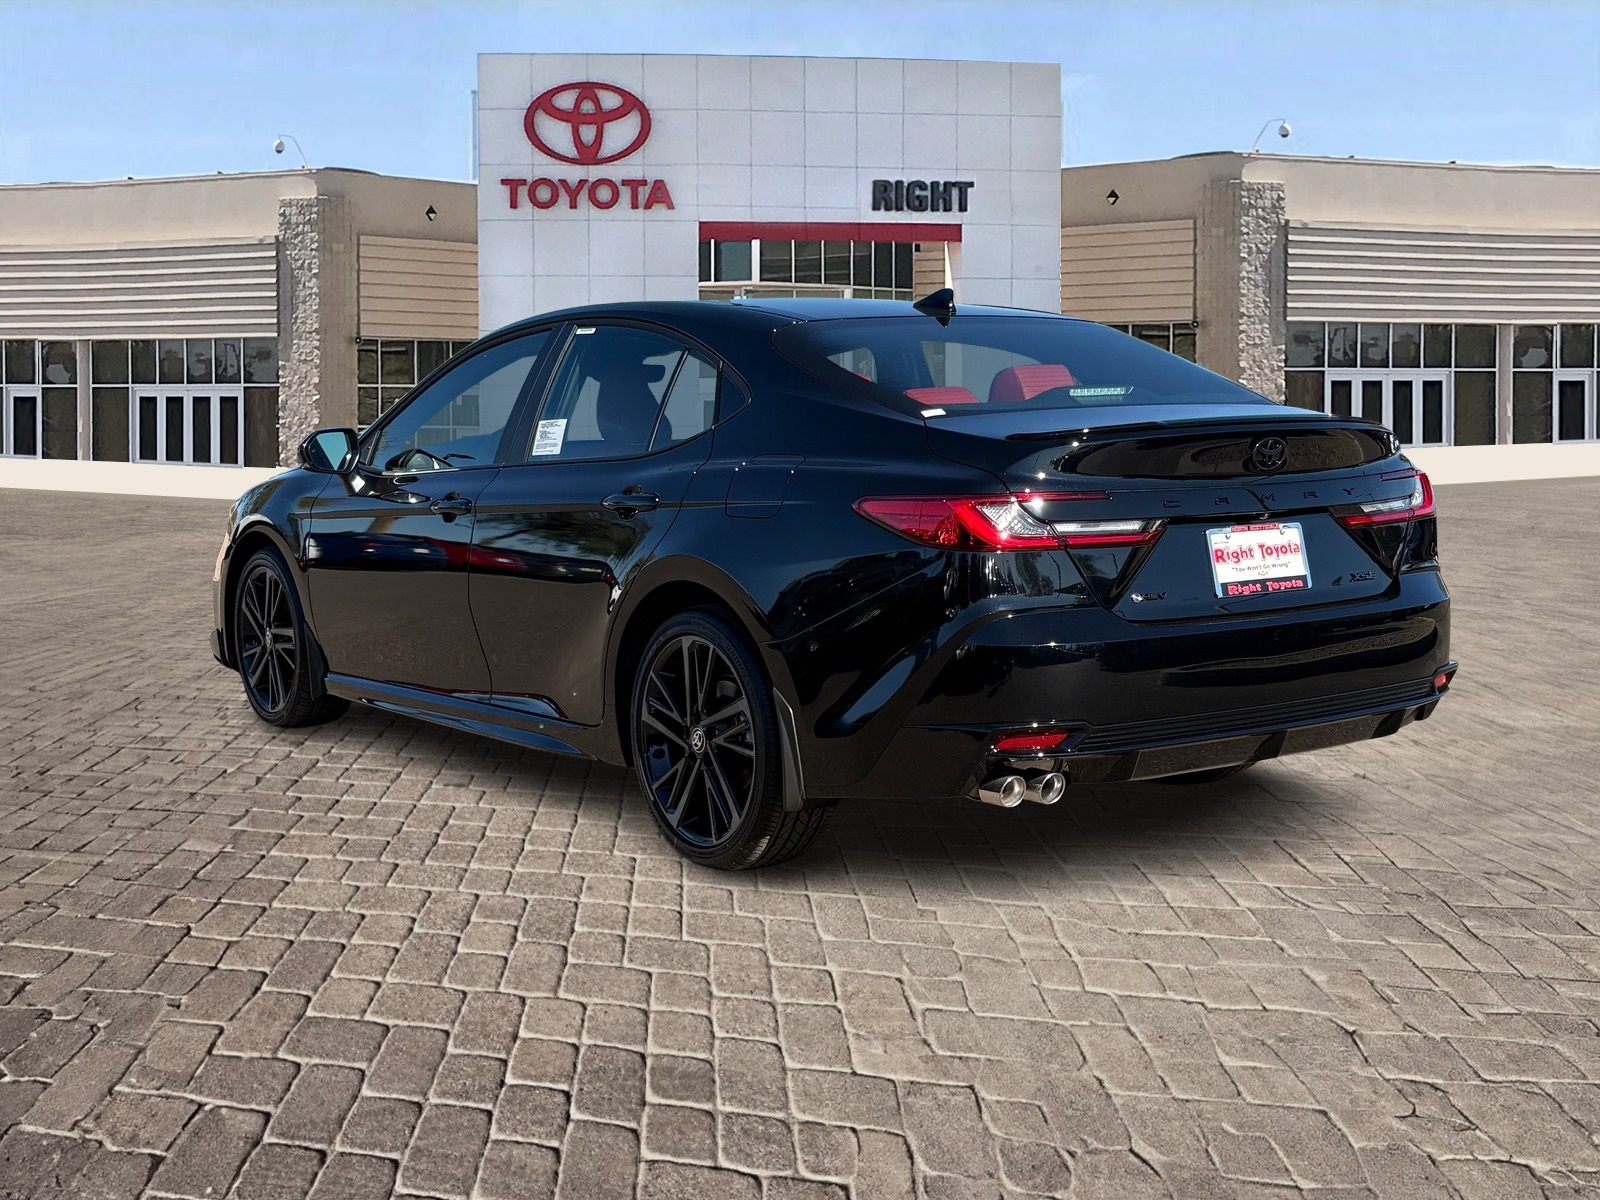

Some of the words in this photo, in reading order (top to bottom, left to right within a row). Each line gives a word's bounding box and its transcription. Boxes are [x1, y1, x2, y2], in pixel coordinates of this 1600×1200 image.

[500, 178, 675, 210] TOYOTA
[872, 179, 975, 213] RIGHT
[1213, 544, 1254, 564] Right
[1257, 540, 1300, 560] Toyota
[1227, 582, 1262, 595] Right
[1266, 579, 1304, 592] Toyota
[1349, 571, 1376, 582] XSE
